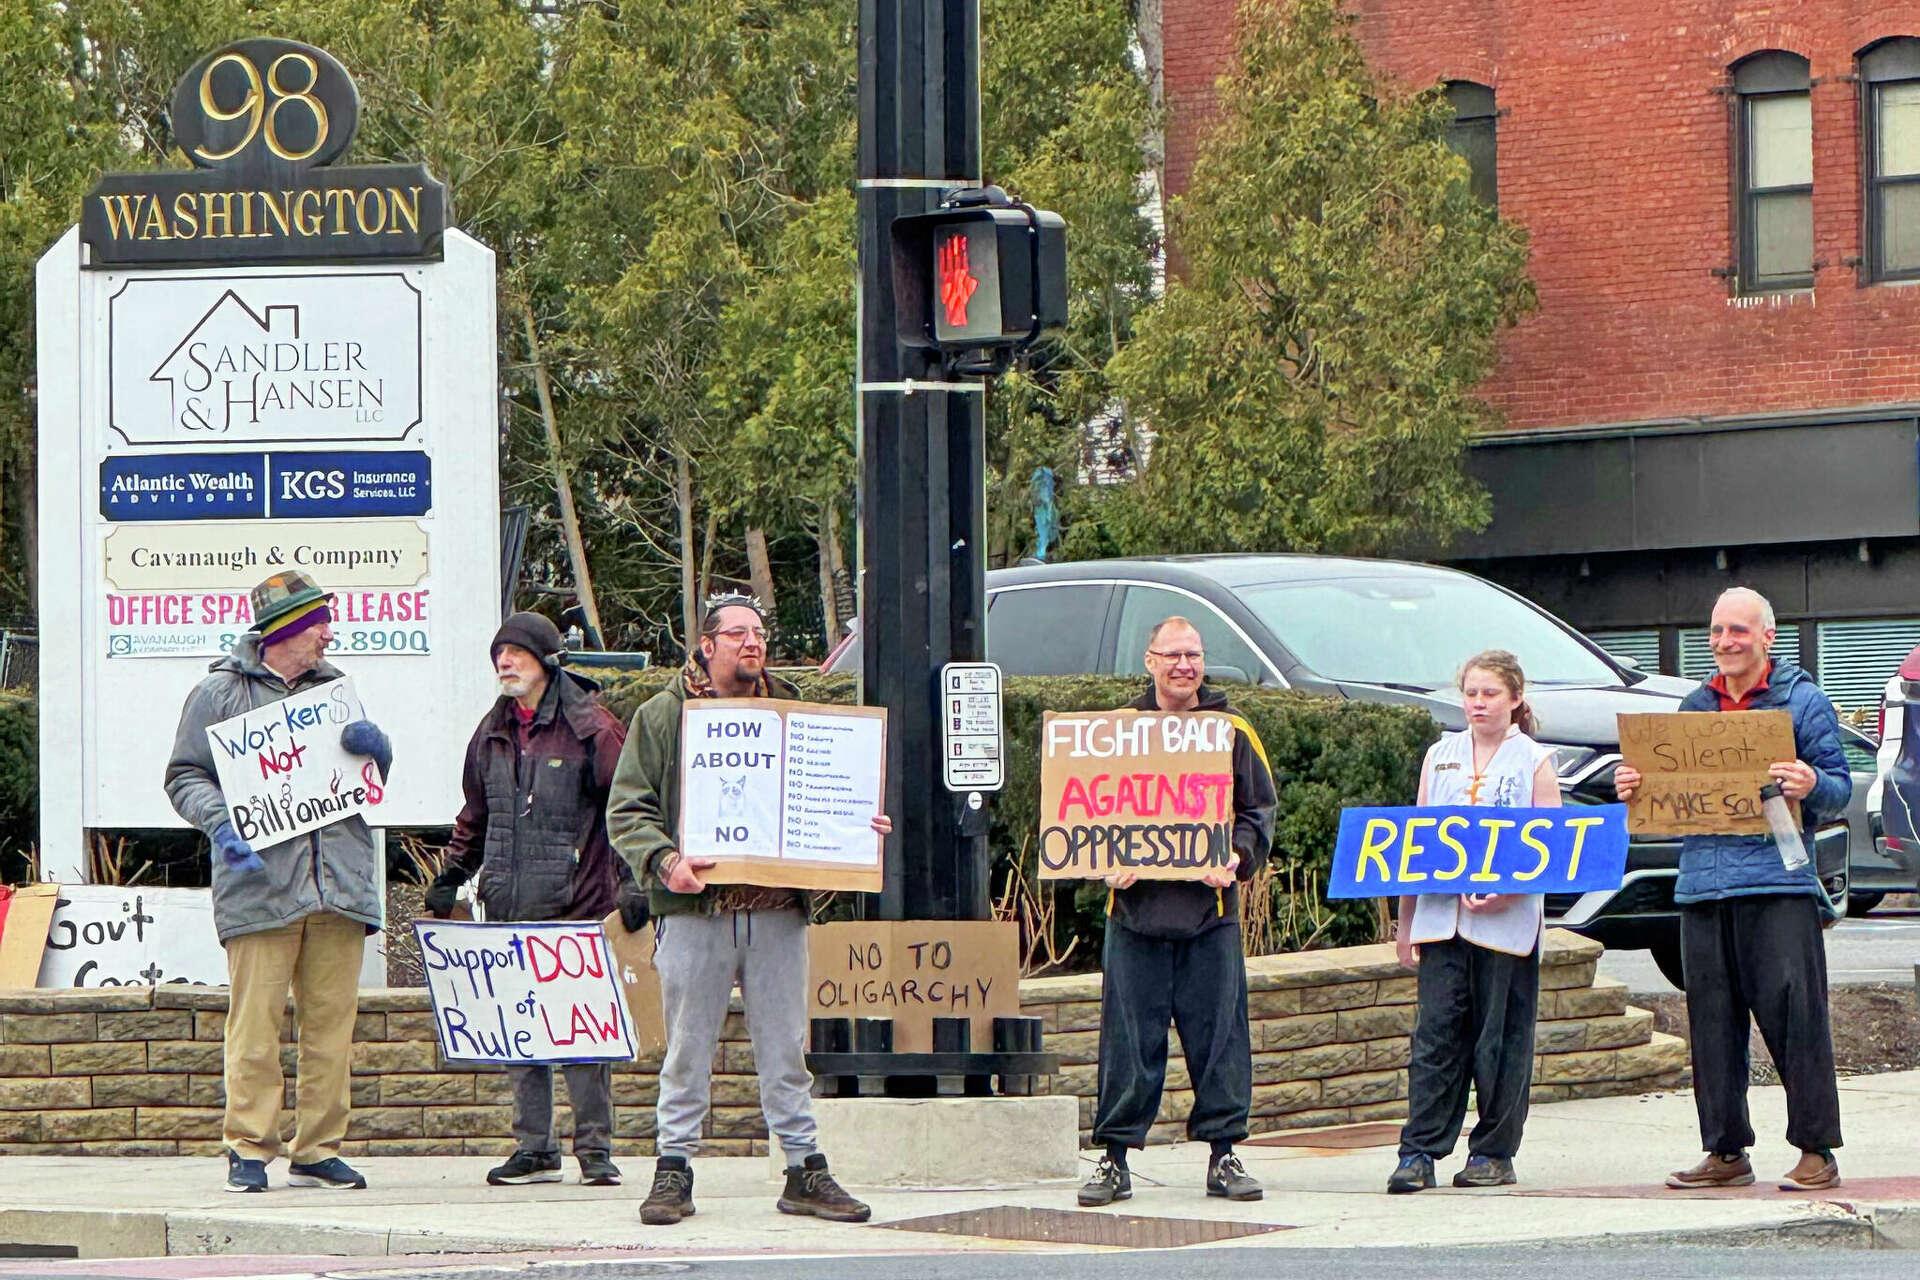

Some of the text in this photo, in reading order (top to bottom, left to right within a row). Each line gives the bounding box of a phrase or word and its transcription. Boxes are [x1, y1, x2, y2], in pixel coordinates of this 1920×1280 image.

[195, 53, 329, 161] 98
[99, 186, 423, 241] WASHINGTON
[184, 342, 367, 392] SANDLER
[180, 372, 384, 433] & HANSEN
[356, 410, 384, 424] LLC
[111, 472, 254, 492] Atlantic Wealth
[280, 471, 345, 500] KGS
[353, 471, 416, 484] Insurance
[398, 486, 416, 498] LLC
[130, 545, 403, 572] Cavanaugh & Company
[108, 594, 194, 626] OFFICE
[201, 595, 252, 625] SPA
[347, 591, 428, 622] LEASE
[706, 721, 763, 739] HOW
[1047, 715, 1233, 758] FIGHT BACK
[258, 735, 307, 780] Not
[691, 752, 776, 770] ABOUT
[1058, 772, 1235, 821] AGAINST
[1650, 790, 1719, 820] MAKE
[715, 825, 750, 843] NO
[1040, 822, 1231, 871] OPPRESSION
[1355, 815, 1605, 883] RESIST
[423, 931, 604, 1000] Support DOJ
[849, 940, 952, 971] NO TO
[817, 976, 993, 1012] OLIGARCHY
[443, 990, 619, 1059] Rule of LAW
